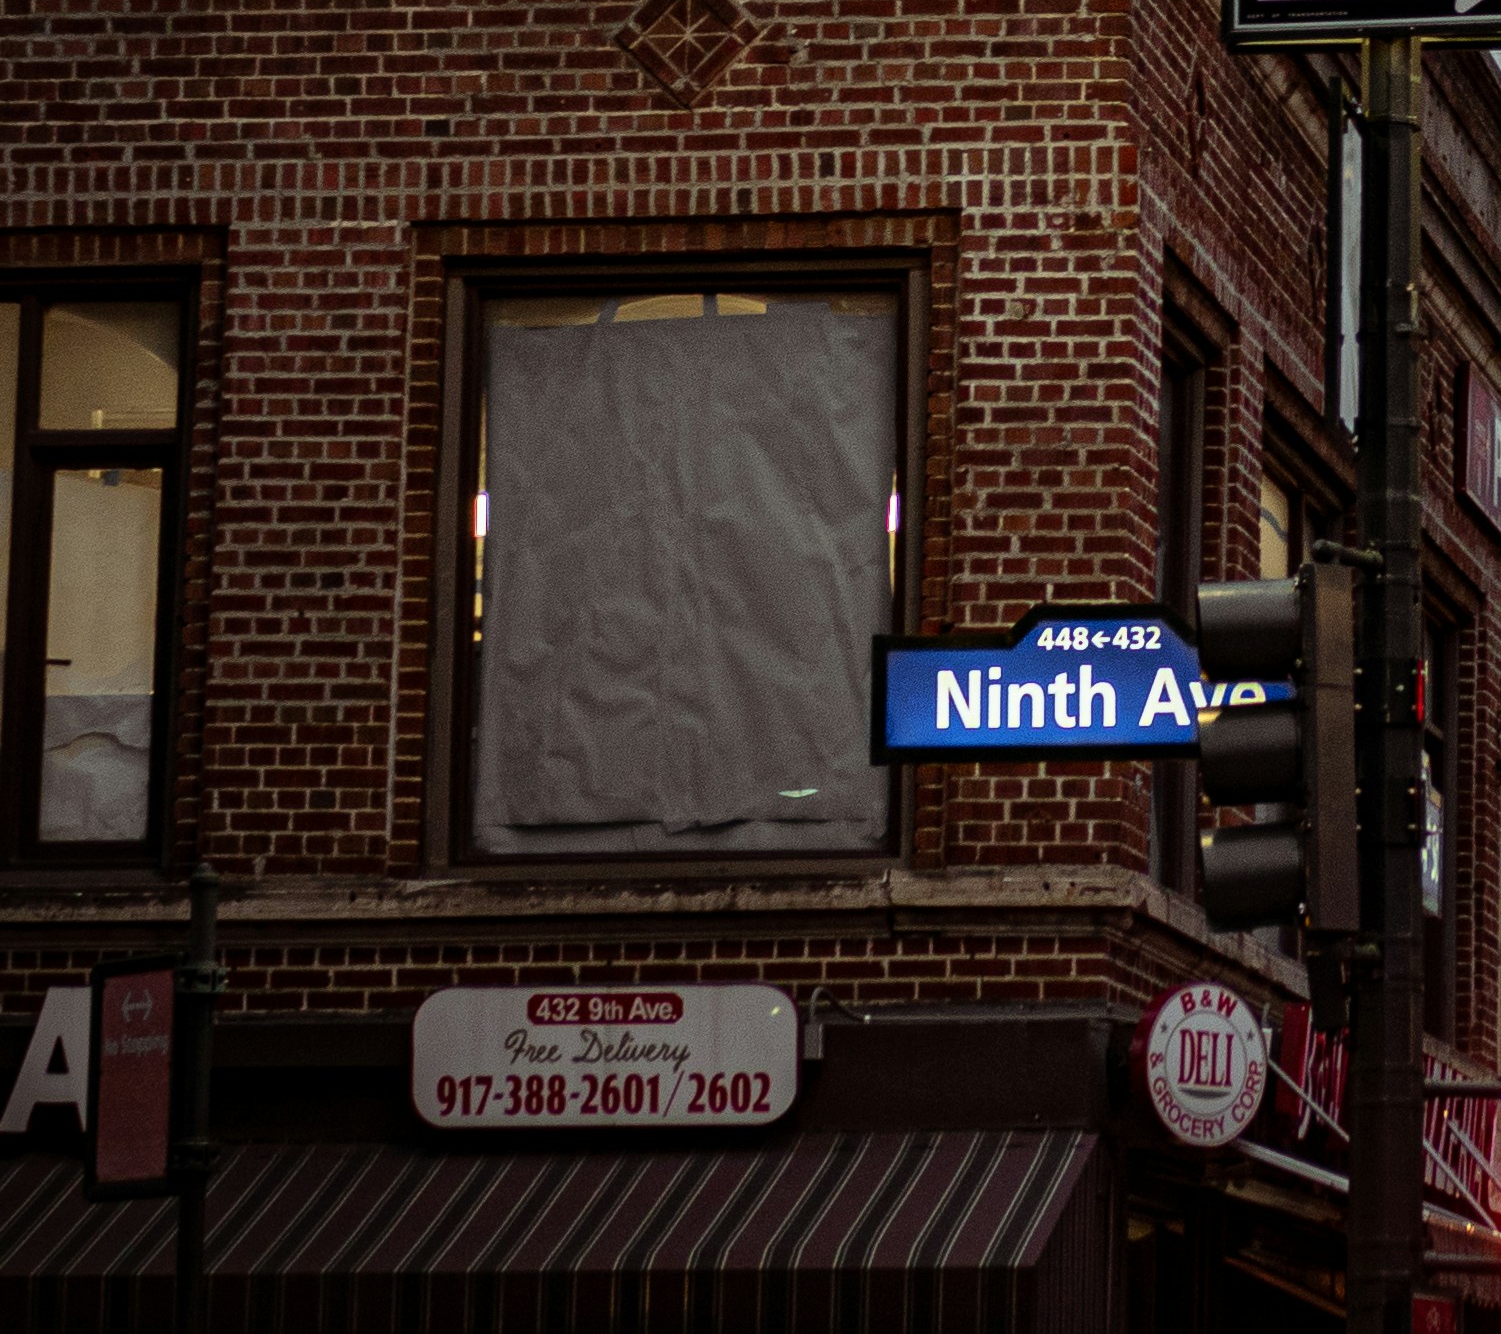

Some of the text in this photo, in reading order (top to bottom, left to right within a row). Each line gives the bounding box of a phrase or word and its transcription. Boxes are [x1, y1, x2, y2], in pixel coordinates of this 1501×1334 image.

[1037, 626, 1161, 651] 448 432
[936, 665, 1116, 729] Ninth
[535, 996, 677, 1021] 432 9th Ave.
[504, 1028, 691, 1073] Free Delivery
[1178, 1028, 1234, 1087] DELI
[1153, 1076, 1226, 1140] GROCERY
[1232, 1059, 1265, 1123] CORP.
